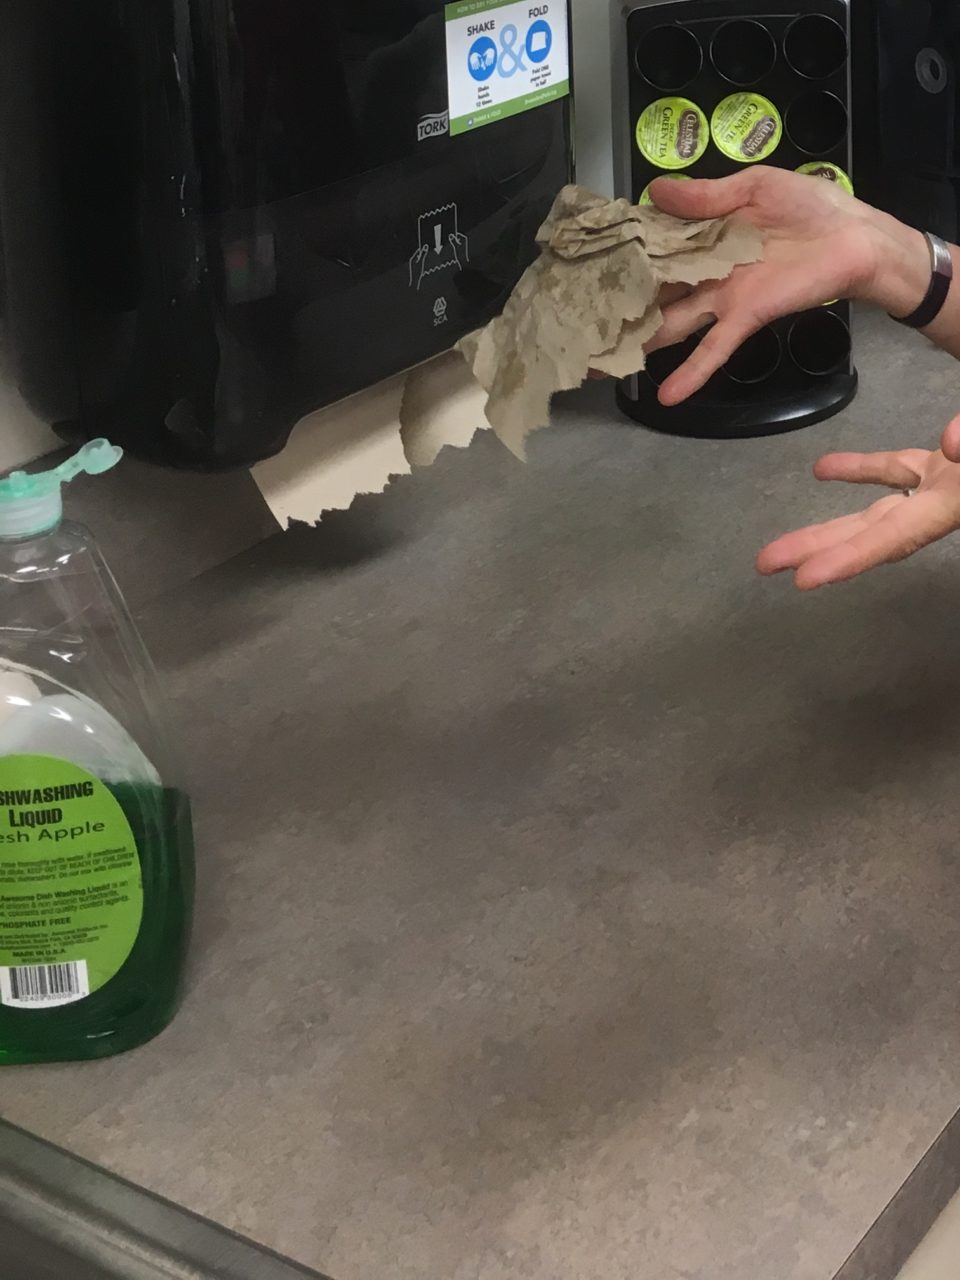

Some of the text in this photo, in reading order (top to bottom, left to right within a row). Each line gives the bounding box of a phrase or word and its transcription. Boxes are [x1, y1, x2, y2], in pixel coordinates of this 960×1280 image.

[528, 4, 548, 19] FOLD
[467, 20, 495, 37] SHAKE
[497, 23, 528, 78] &
[734, 103, 758, 130] GREEN
[419, 118, 447, 137] TORK
[658, 106, 673, 158] GREEN TEA
[683, 113, 697, 154] CELESTIAL
[746, 120, 775, 154] CELESTIAL
[433, 314, 449, 326] SCA
[38, 821, 105, 842] Apple
[54, 888, 86, 898] Washing
[87, 883, 110, 894] Liquid
[49, 917, 71, 926] FREE
